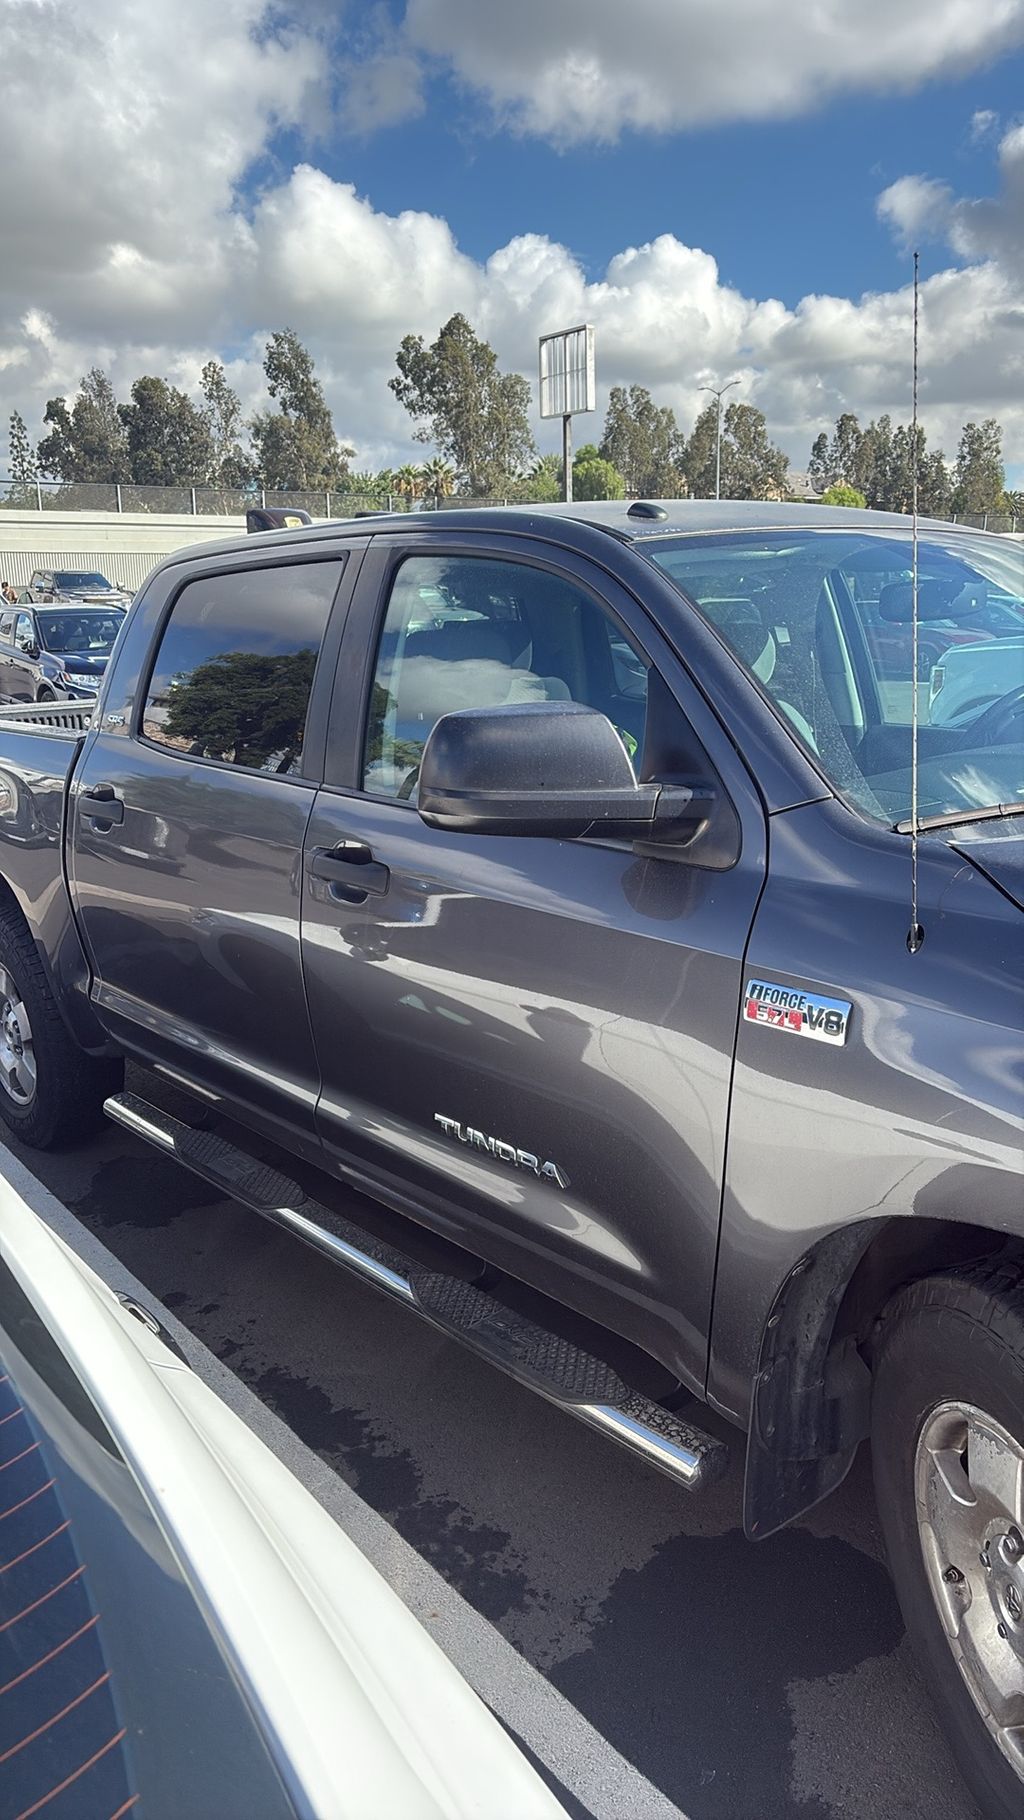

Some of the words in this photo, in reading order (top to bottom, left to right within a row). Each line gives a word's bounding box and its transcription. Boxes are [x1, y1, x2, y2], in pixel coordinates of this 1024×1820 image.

[757, 1004, 796, 1029] 5.7L
[806, 1005, 844, 1036] V8
[434, 1112, 570, 1189] TUNDRA
